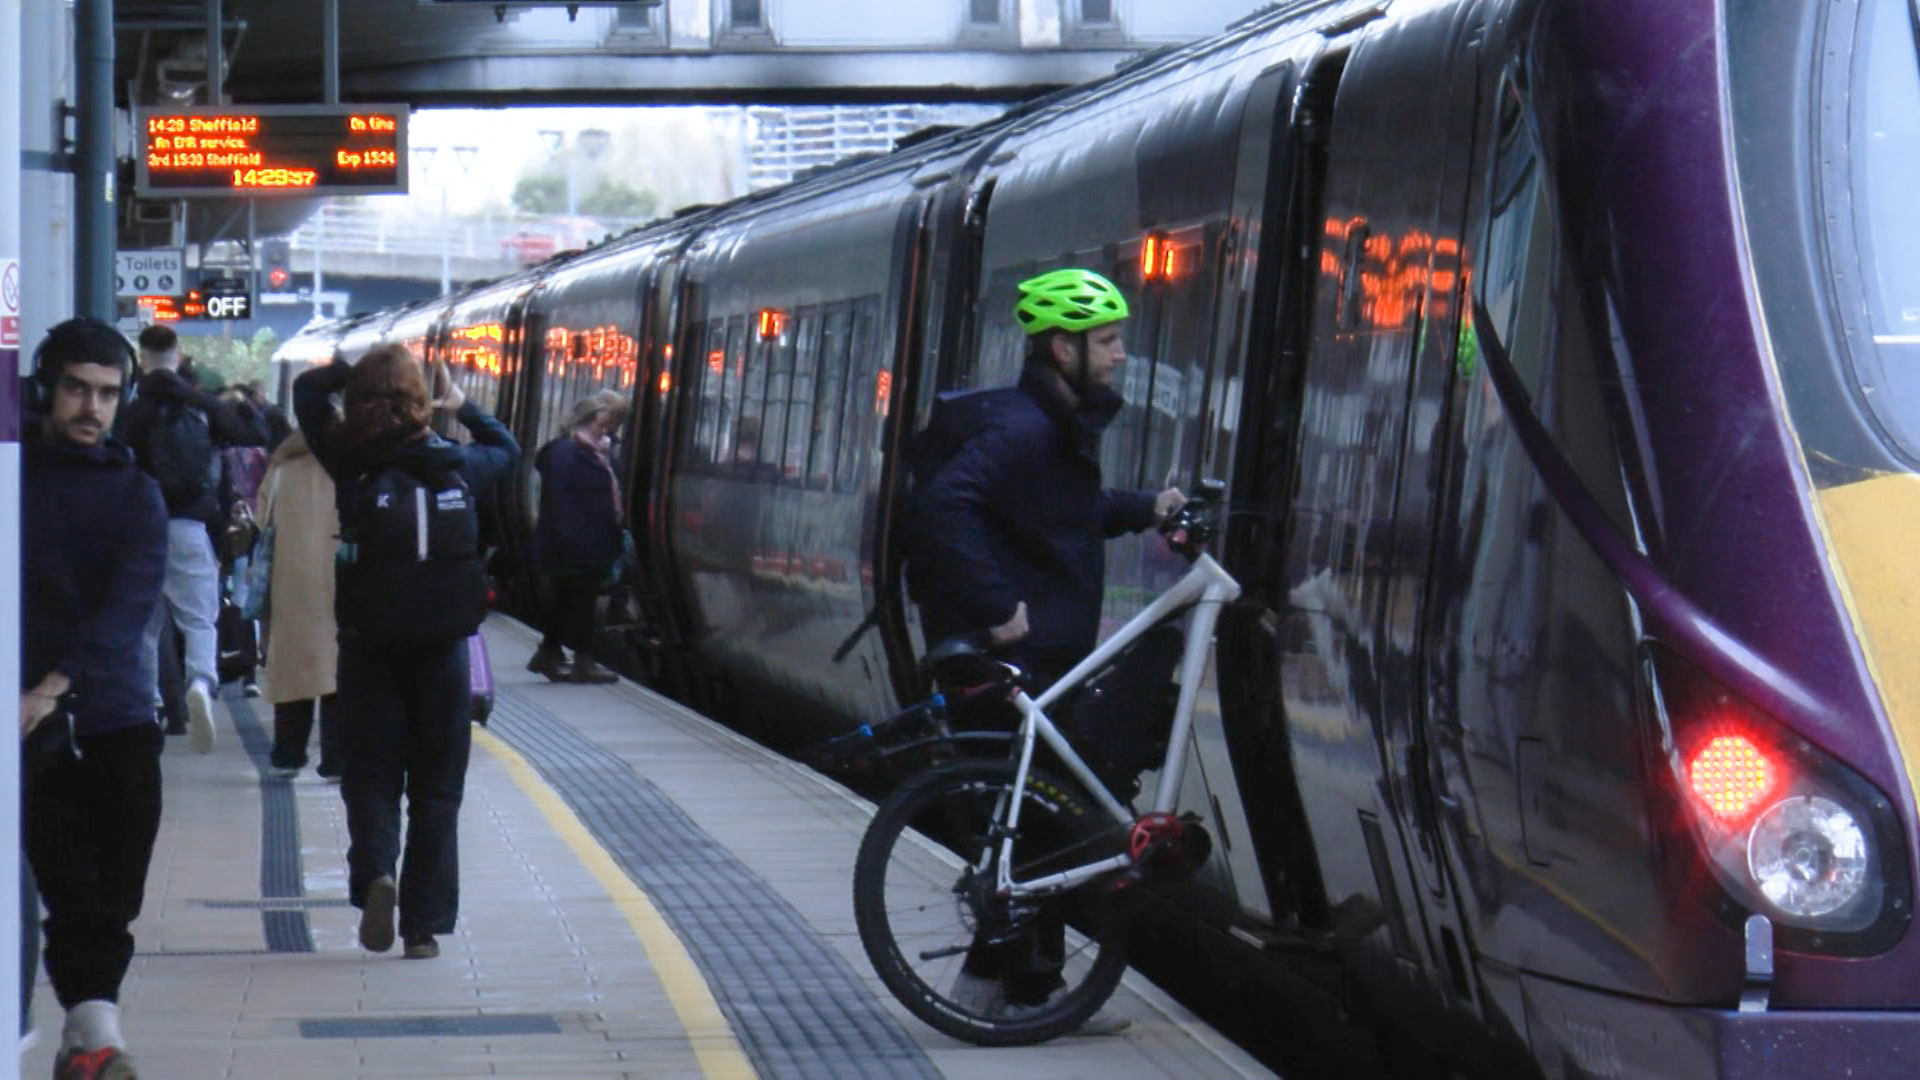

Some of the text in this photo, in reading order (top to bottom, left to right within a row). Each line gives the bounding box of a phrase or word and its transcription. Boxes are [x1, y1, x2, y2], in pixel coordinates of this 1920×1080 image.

[189, 117, 257, 132] Sheffield
[350, 117, 366, 130] On
[155, 136, 170, 149] An
[174, 136, 198, 149] EMR
[207, 152, 261, 166] Sheffield
[338, 151, 362, 168] Exp
[124, 256, 178, 270] Toilets
[207, 296, 248, 318] OFF
